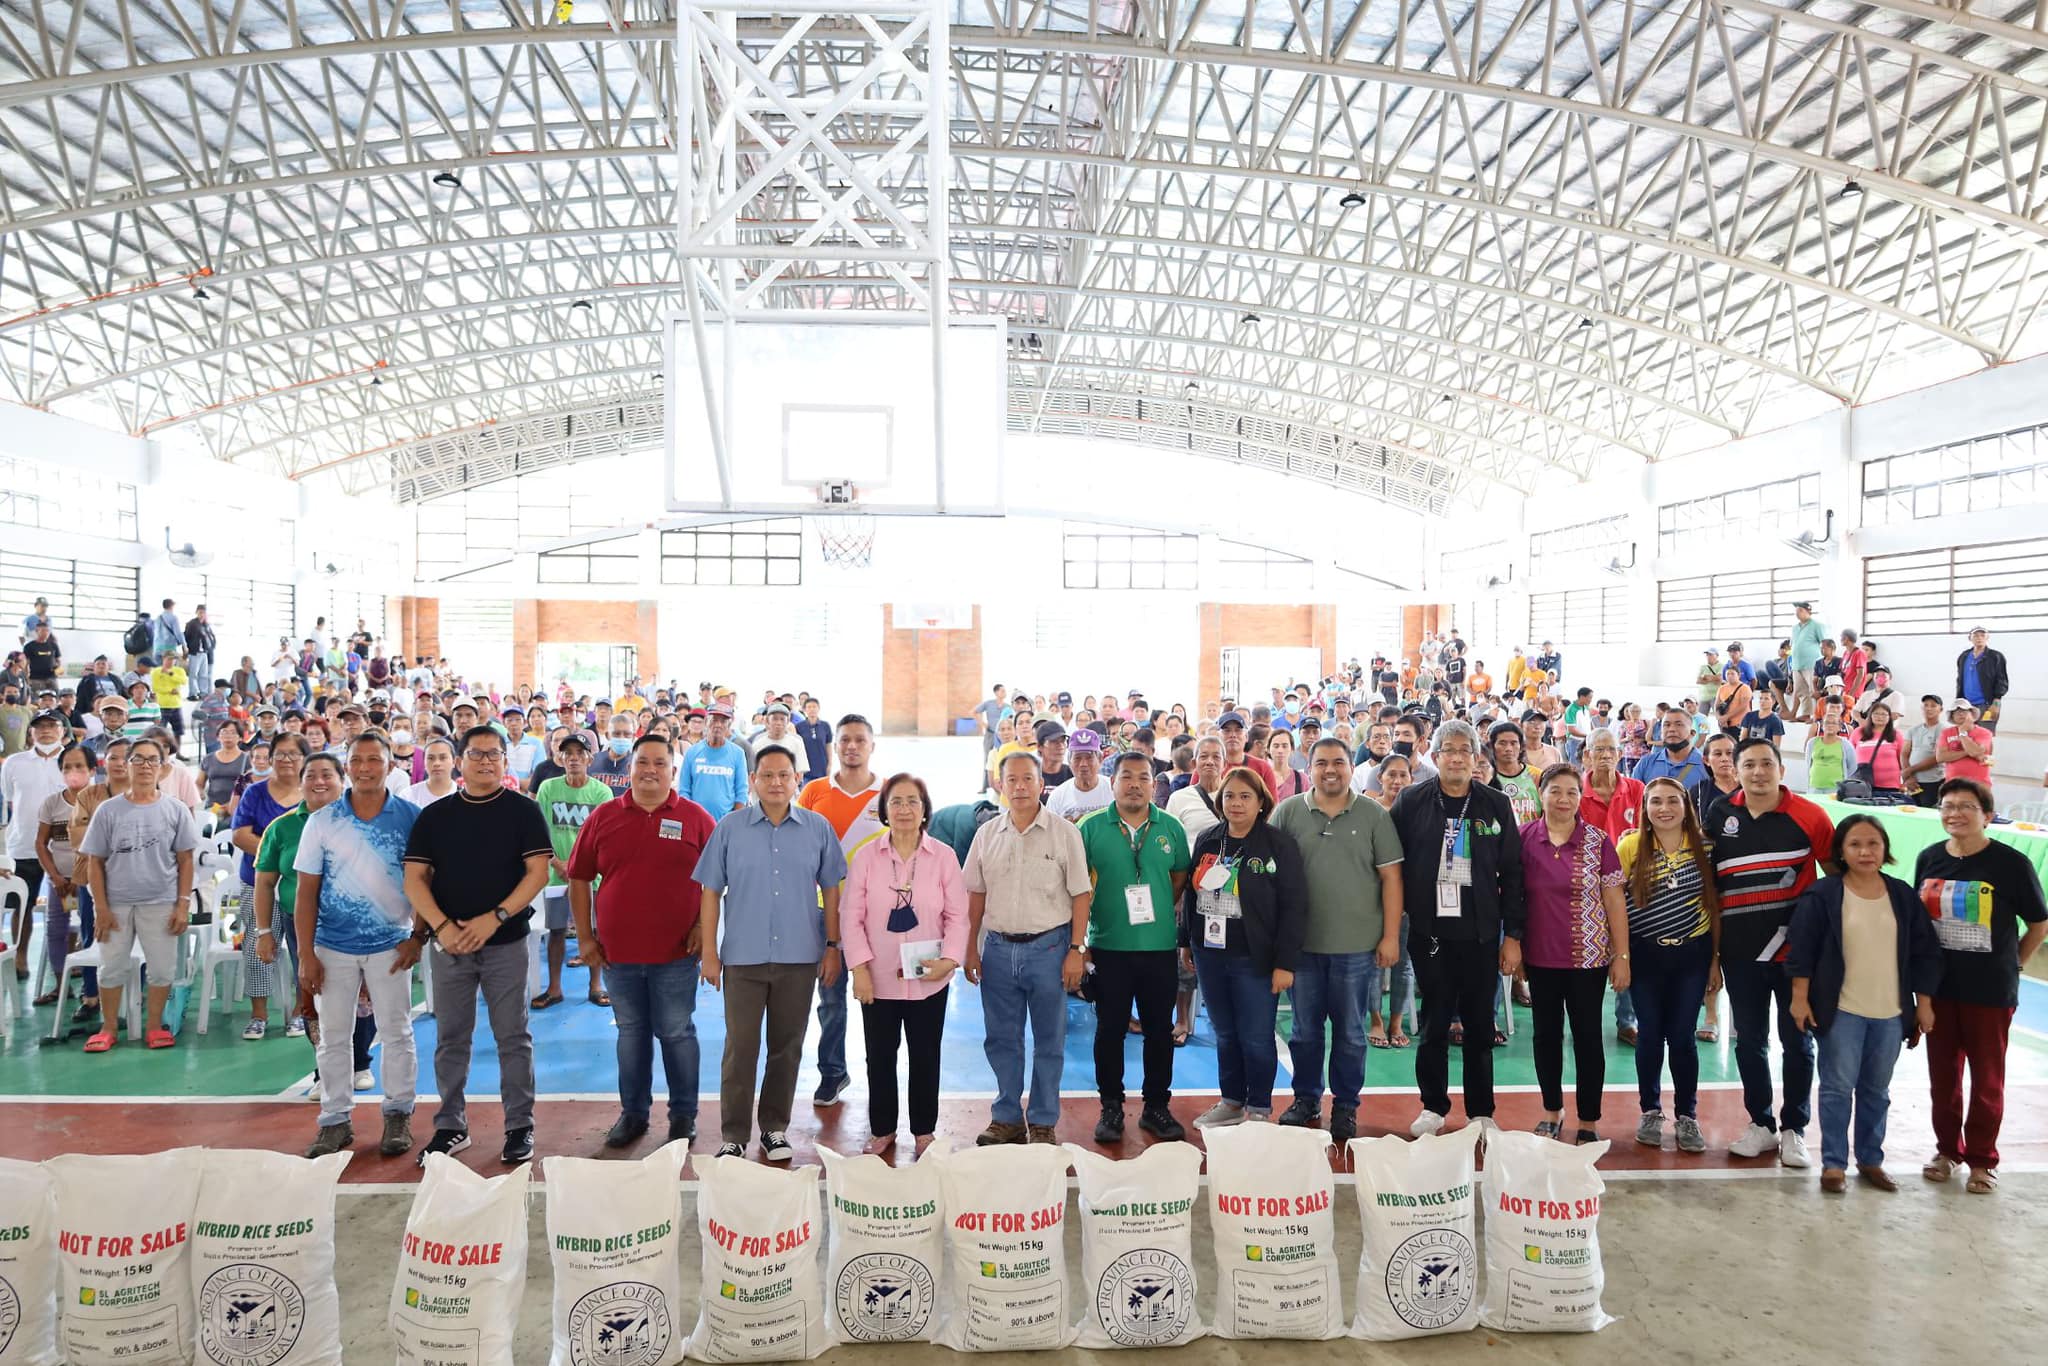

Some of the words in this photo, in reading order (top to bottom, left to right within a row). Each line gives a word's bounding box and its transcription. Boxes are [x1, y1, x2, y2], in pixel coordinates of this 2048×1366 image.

[1131, 1203, 1157, 1216] RICE
[1161, 1198, 1191, 1216] SEEDS
[1219, 1194, 1251, 1215] NOT
[1258, 1198, 1290, 1216] FOR
[1295, 1190, 1328, 1216] SALE
[1377, 1192, 1417, 1207] HYBRID
[1418, 1192, 1446, 1207] RICE
[1500, 1192, 1532, 1216] NOT
[1539, 1200, 1571, 1220] FOR
[1575, 1197, 1598, 1219] SAL
[873, 1206, 899, 1220] RICE
[903, 1200, 936, 1219] SEEDS
[955, 1212, 987, 1231] NOT
[992, 1213, 1025, 1233] FOR
[1031, 1202, 1063, 1231] SALE
[197, 1221, 239, 1238] HYBRID
[242, 1225, 272, 1239] RICE
[275, 1218, 313, 1238] SEEDS
[557, 1235, 601, 1252] HYBRID
[605, 1234, 633, 1252] RICE
[637, 1219, 671, 1244] SEEDS
[1285, 1226, 1296, 1235] 15
[1297, 1224, 1309, 1235] kg
[1565, 1229, 1576, 1238] 15
[60, 1230, 92, 1255] NOT
[97, 1237, 133, 1257] FOR
[140, 1222, 186, 1254] SALE
[709, 1218, 738, 1251] NOT
[740, 1236, 771, 1258] FOR
[776, 1221, 810, 1253] SALE
[1020, 1241, 1031, 1250] 15
[1032, 1240, 1043, 1251] kg
[404, 1232, 420, 1256] OT
[422, 1240, 456, 1265] FOR
[458, 1242, 502, 1266] SALE
[1266, 1247, 1274, 1255] SL
[1280, 1242, 1315, 1254] AGRITECH
[1266, 1251, 1316, 1262] CORPORATION
[1000, 1263, 1008, 1272] SL
[1014, 1257, 1050, 1271] AGRITECH
[1389, 1232, 1435, 1286] PROVINCE
[1439, 1232, 1457, 1246] OF
[123, 1266, 136, 1276] 15
[138, 1264, 152, 1274] kg
[762, 1265, 773, 1276] 15
[775, 1263, 786, 1273] kg
[1000, 1267, 1050, 1279] CORPORATION
[443, 1275, 453, 1285] 15
[455, 1275, 467, 1288] kg
[739, 1288, 748, 1296] SL
[753, 1277, 792, 1296] AGRITECH
[839, 1256, 884, 1300] PROVINCE
[890, 1257, 908, 1270] OF
[908, 1264, 931, 1303] ILOILO
[1100, 1253, 1148, 1309] PROVINCE
[1150, 1253, 1169, 1267] OF
[1169, 1257, 1192, 1299] ILOILO
[99, 1288, 108, 1298] SL
[114, 1281, 160, 1298] AGRITECH
[99, 1290, 160, 1306] CORPORATION
[248, 1268, 271, 1282] OF
[271, 1277, 300, 1318] ILOILO
[739, 1285, 792, 1302] CORPORATION
[420, 1303, 469, 1315] CORPORATION
[433, 1297, 471, 1306] AGRITECH
[1296, 1300, 1301, 1308] &
[1303, 1296, 1321, 1306] above
[571, 1287, 619, 1342] PROVINCE
[623, 1286, 645, 1298] OF
[1028, 1315, 1033, 1324] &
[1035, 1311, 1055, 1323] above
[1397, 1301, 1446, 1327] OFFICIAL
[1449, 1297, 1467, 1318] SEAL
[264, 1337, 293, 1362] SEAL
